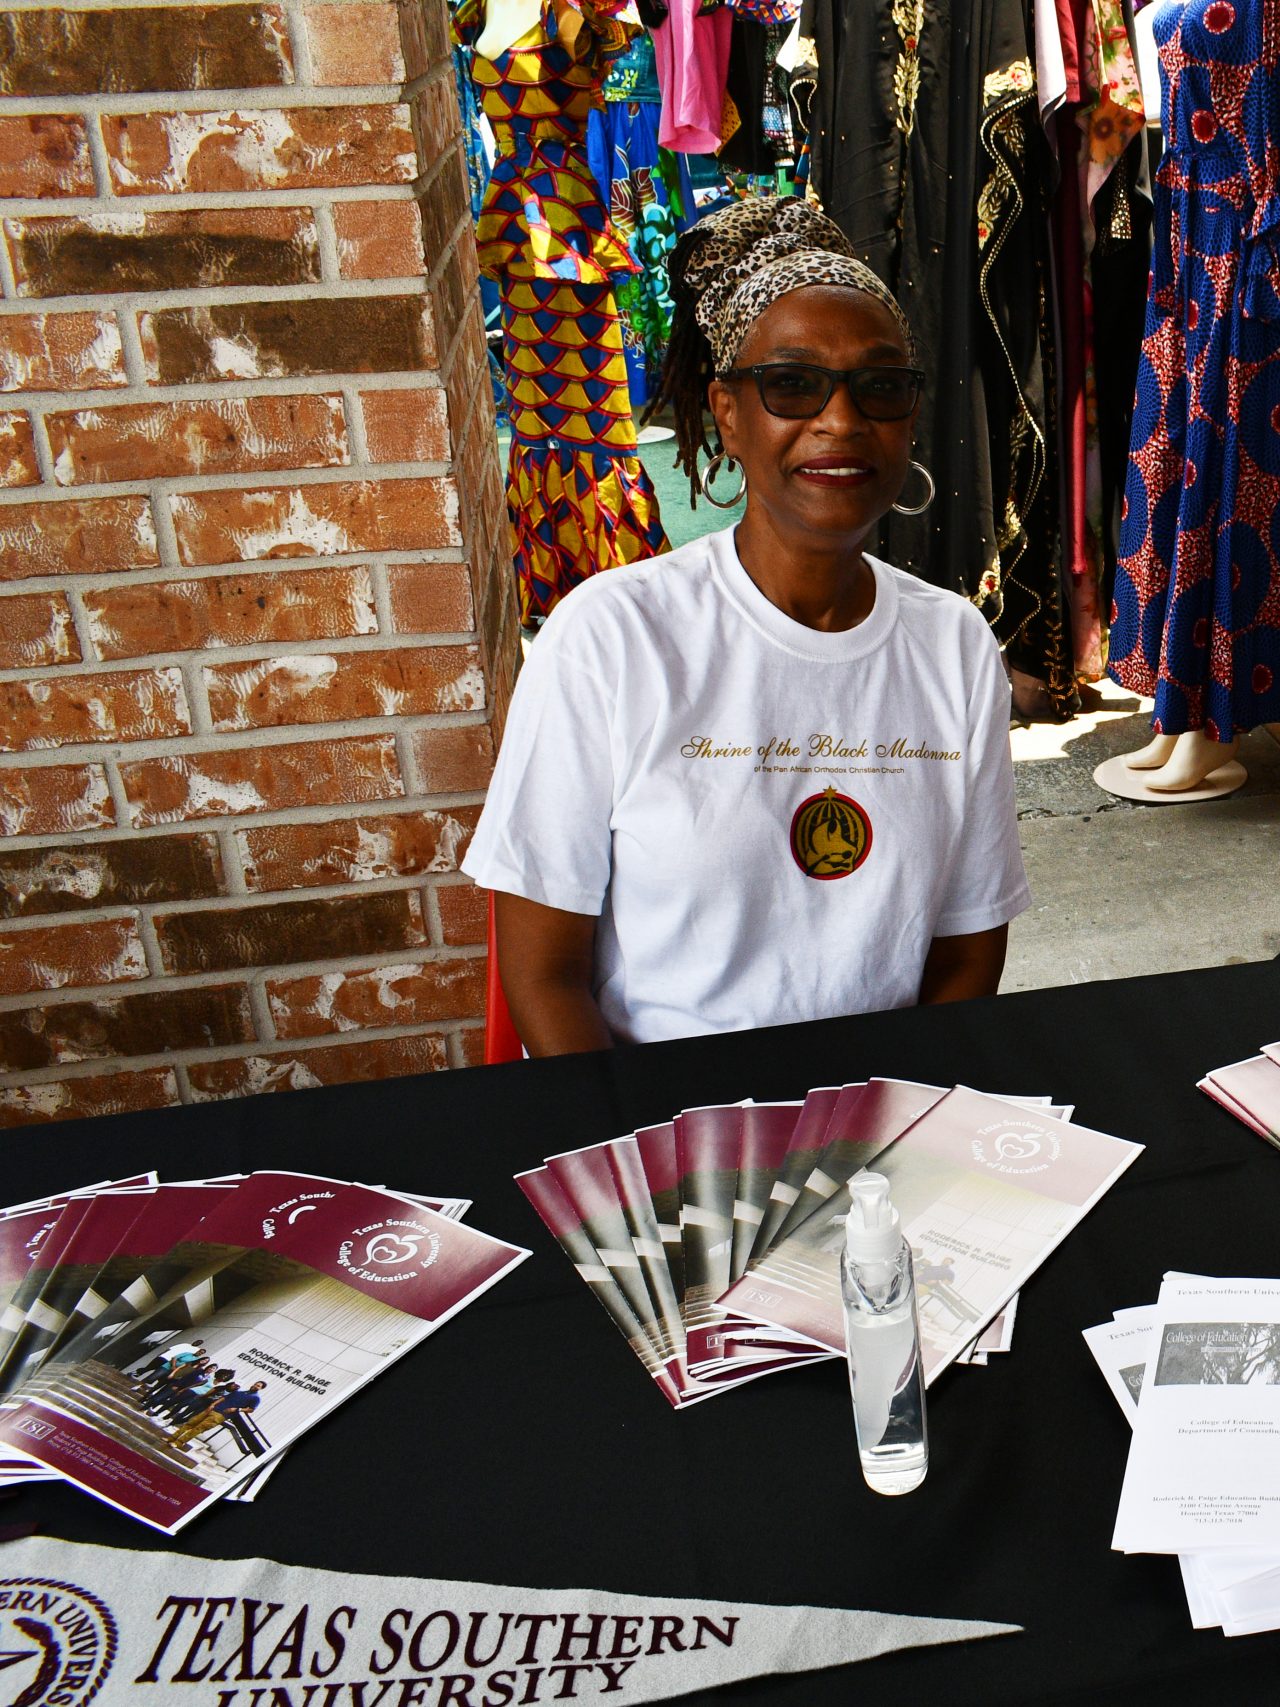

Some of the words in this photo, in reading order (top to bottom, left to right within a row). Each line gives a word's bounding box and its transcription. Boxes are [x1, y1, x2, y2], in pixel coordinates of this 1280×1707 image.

[680, 735, 752, 758] Shrine
[757, 737, 777, 764] of
[775, 738, 800, 756] the
[807, 734, 869, 758] Black
[875, 738, 962, 761] Madonna
[337, 1241, 354, 1267] College
[348, 1266, 364, 1275] of
[358, 1271, 418, 1282] Education
[351, 1222, 383, 1236] Texas
[385, 1218, 430, 1234] Southern
[420, 1232, 442, 1269] University
[1166, 1331, 1196, 1345] College
[237, 1352, 287, 1379] EDUCATION
[285, 1376, 327, 1395] BUILDING
[248, 1347, 294, 1372] RODERICK
[304, 1373, 332, 1388] PAIGE
[19, 1417, 51, 1436] TSU
[134, 1595, 358, 1684] TEXAS
[368, 1608, 741, 1675] SOUTHERN
